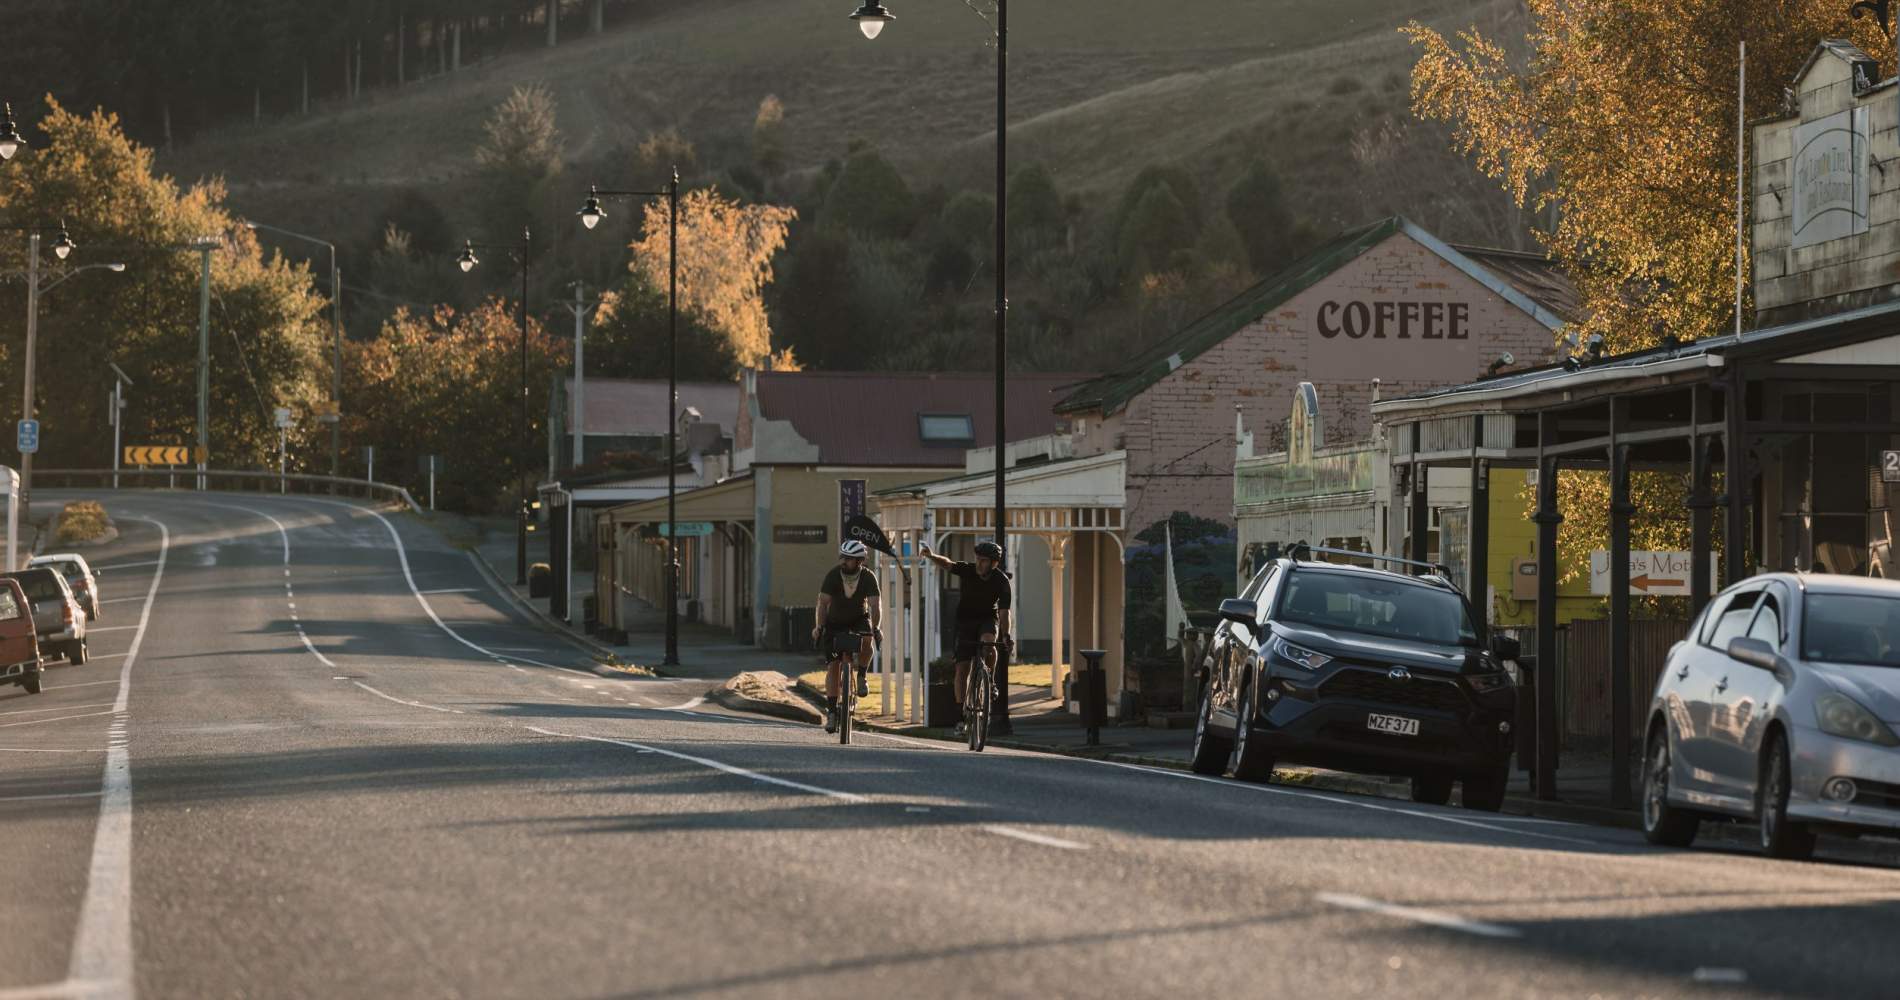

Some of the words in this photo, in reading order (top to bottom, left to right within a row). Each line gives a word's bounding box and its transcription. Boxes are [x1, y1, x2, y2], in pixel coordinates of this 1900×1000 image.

[1317, 301, 1469, 339] COFFEE
[851, 525, 880, 543] OPEN
[1368, 715, 1416, 734] MZF371
